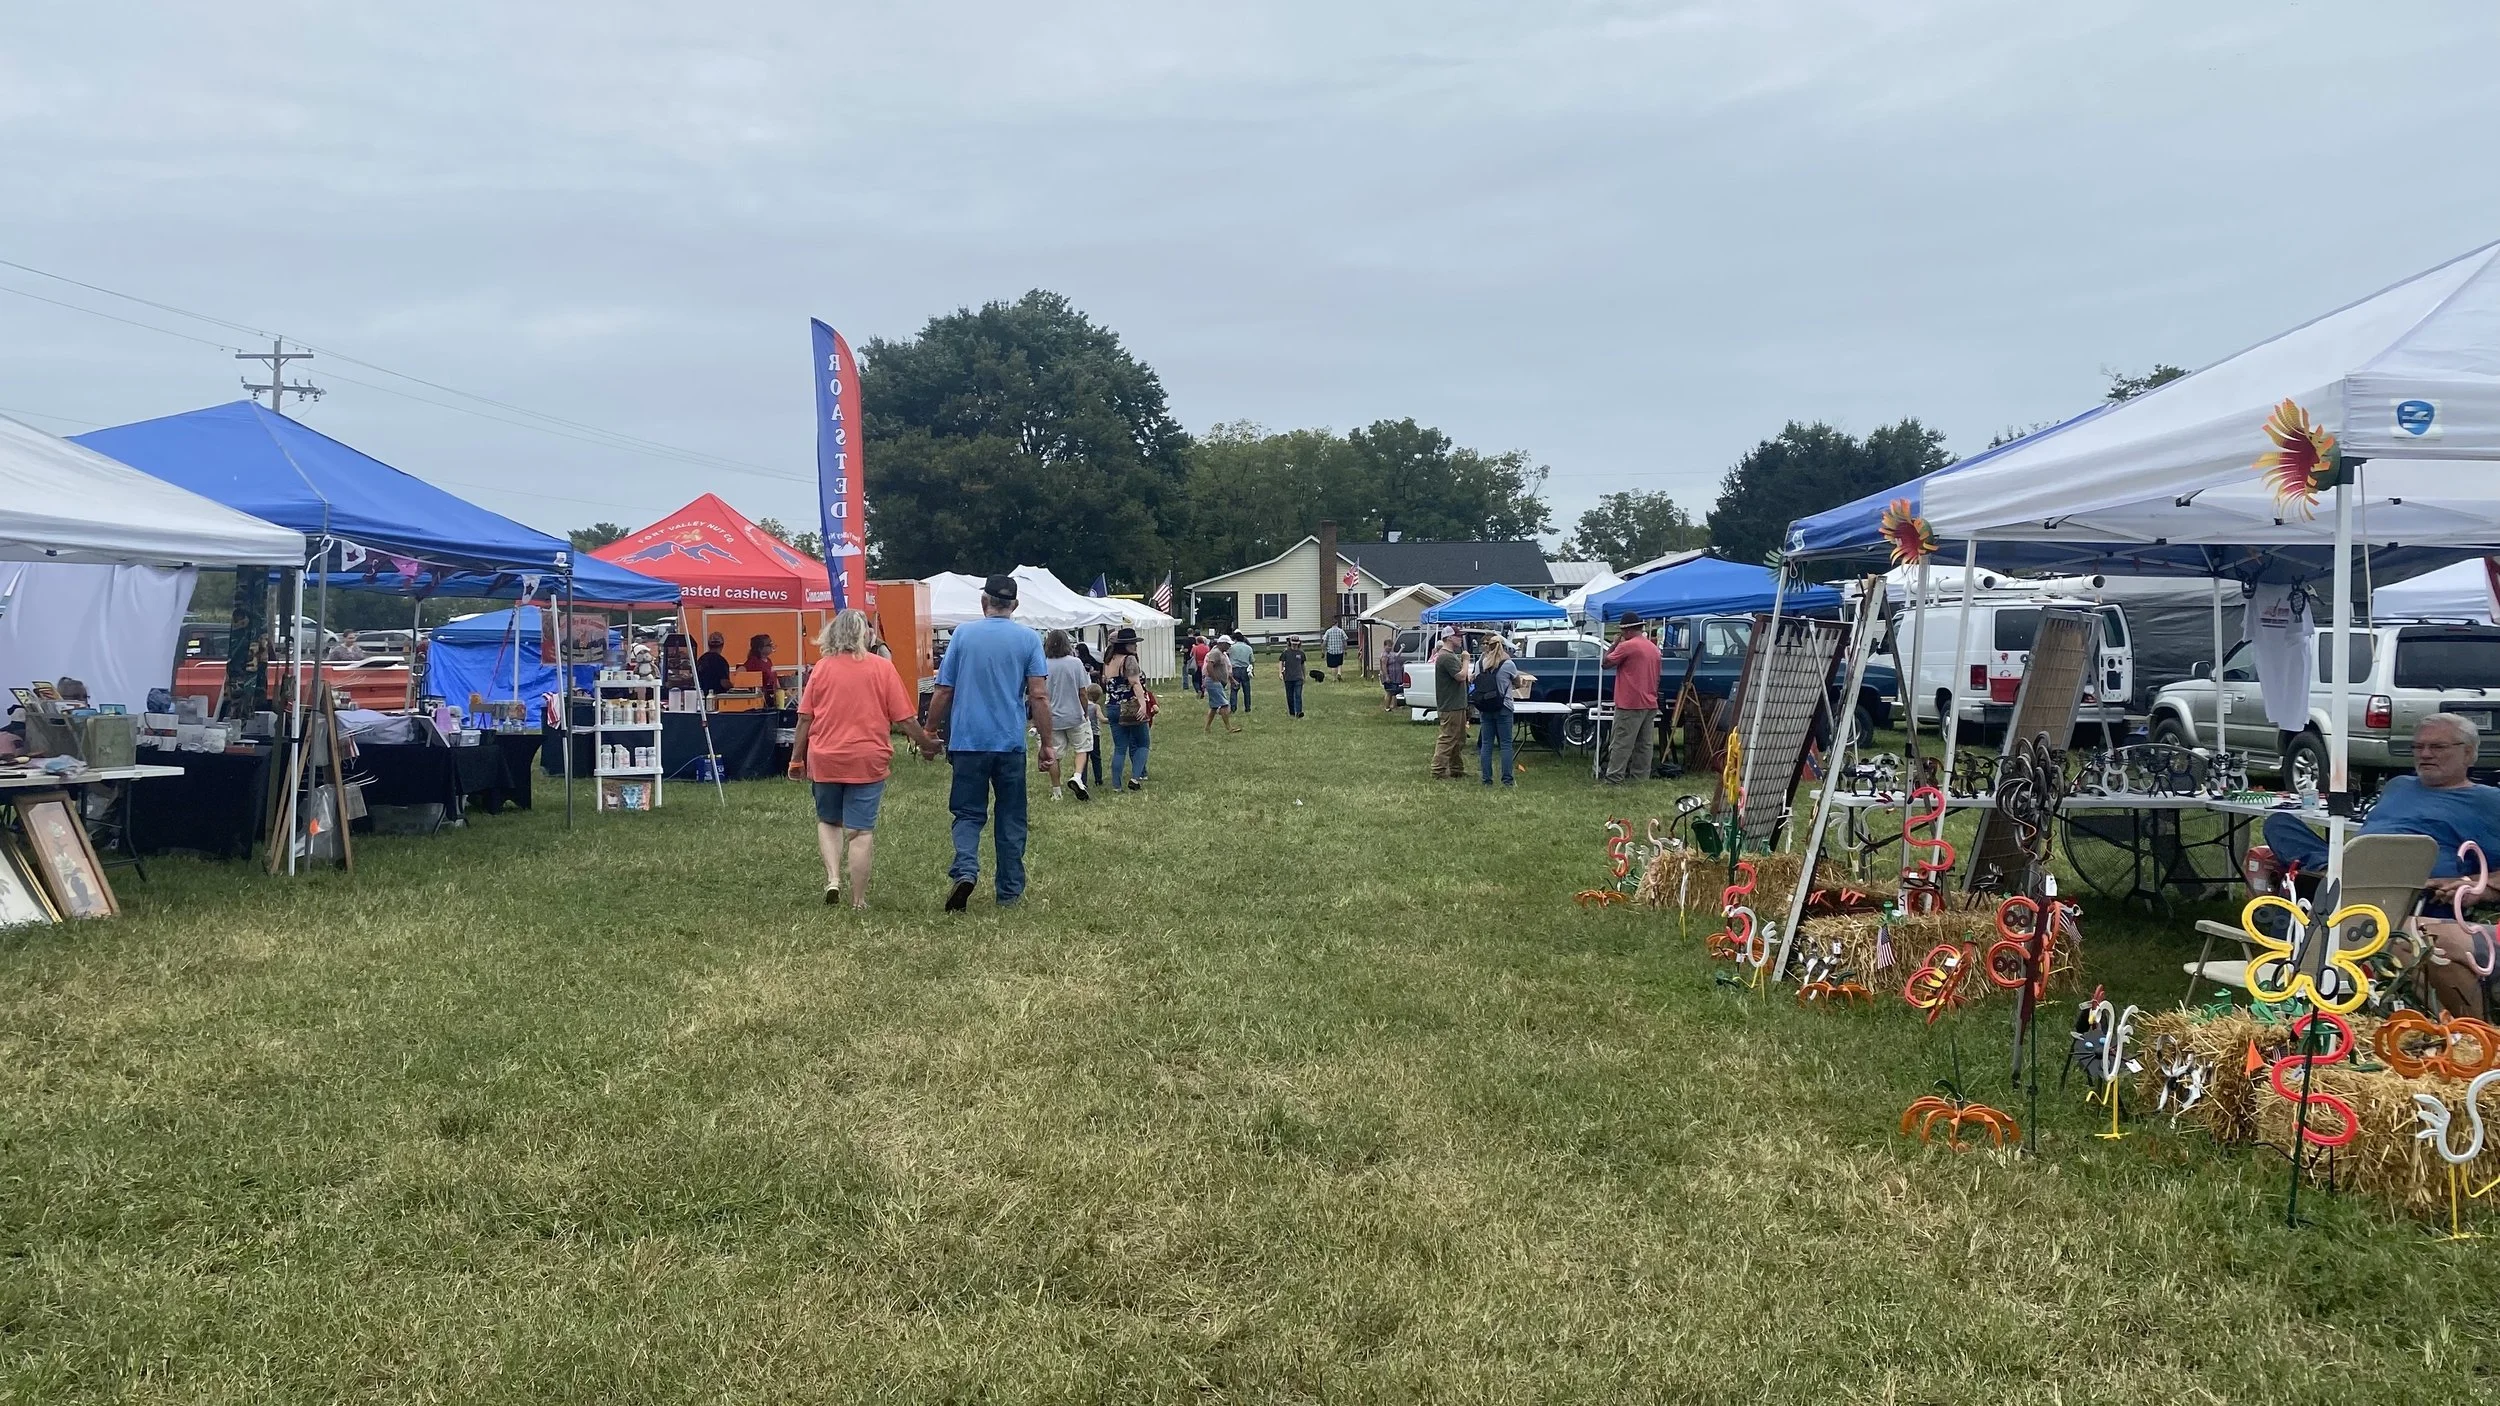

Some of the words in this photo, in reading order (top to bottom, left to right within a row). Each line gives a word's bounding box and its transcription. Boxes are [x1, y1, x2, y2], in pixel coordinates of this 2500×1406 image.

[637, 529, 664, 543] FORT
[668, 520, 706, 530] VALLEY
[707, 523, 726, 534] NUT
[680, 585, 720, 598] asted
[726, 587, 788, 601] cashews
[1808, 889, 1827, 906] VT
[1841, 887, 1866, 905] VT
